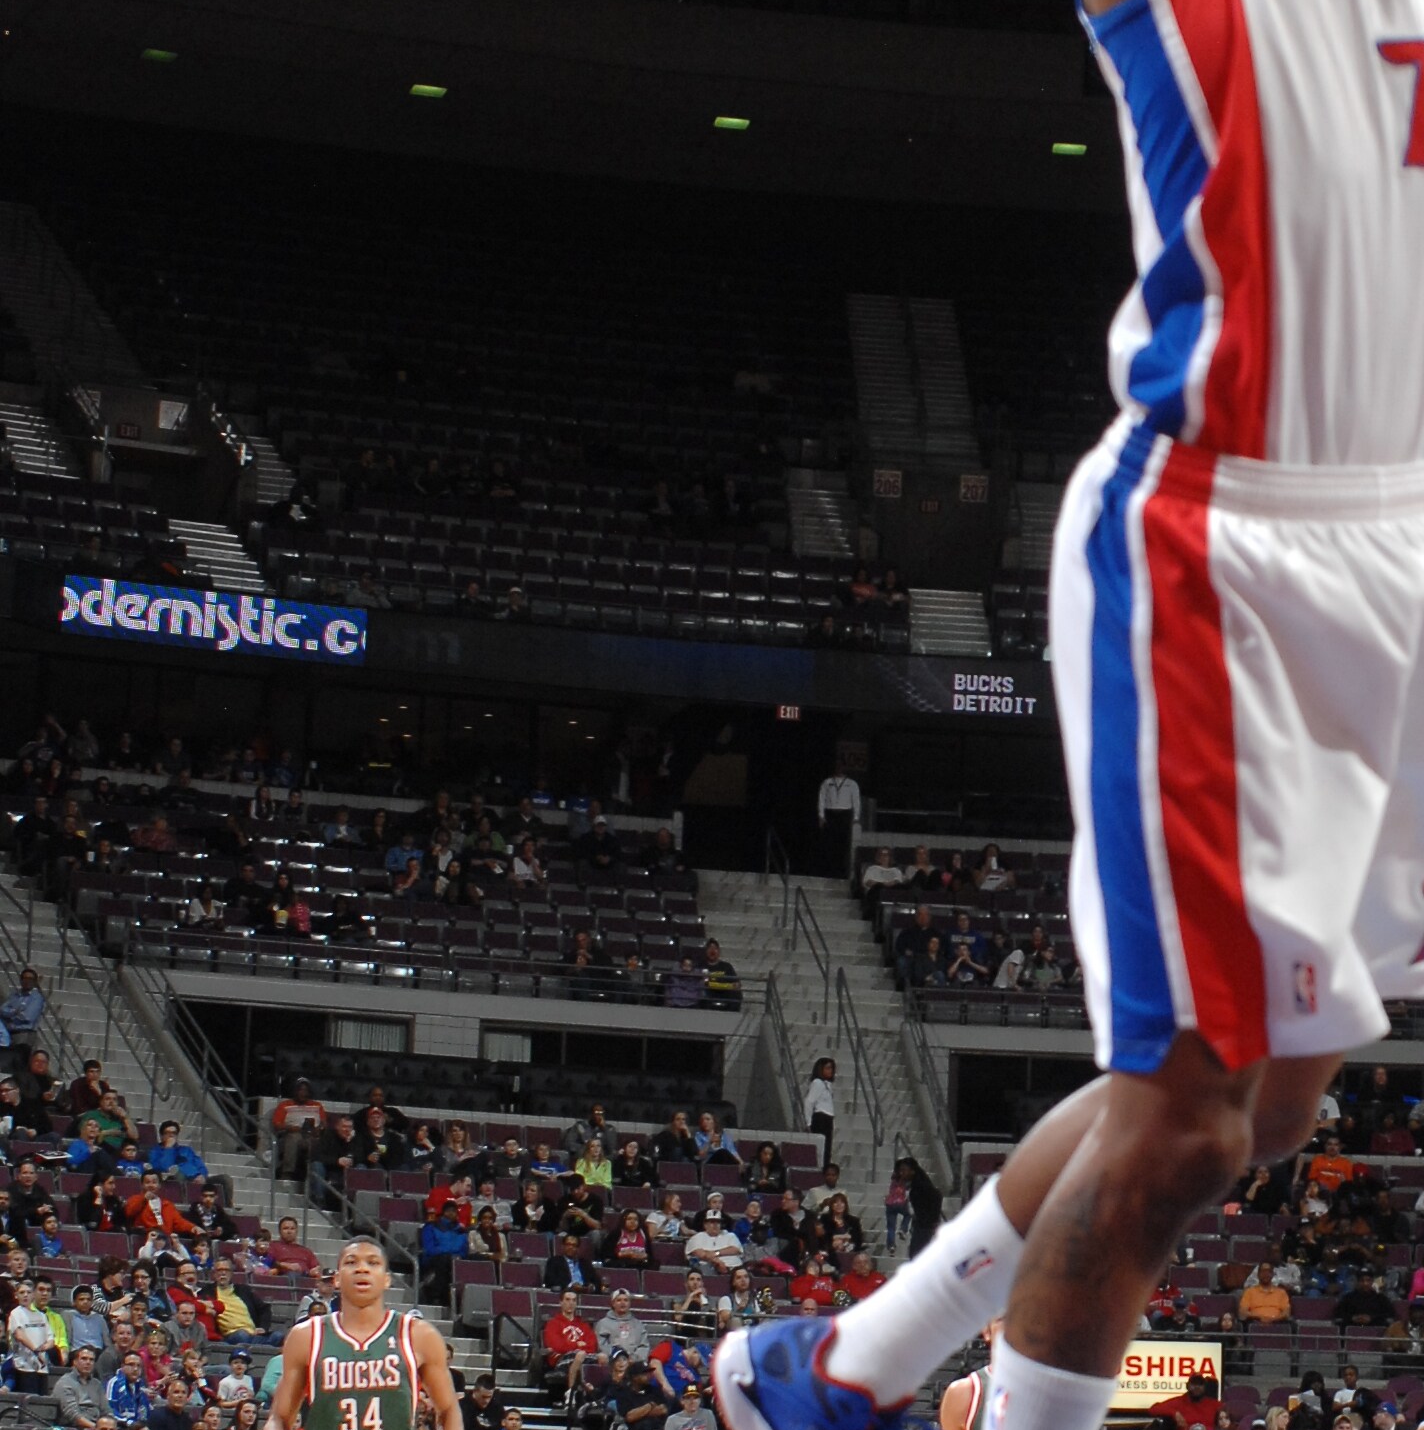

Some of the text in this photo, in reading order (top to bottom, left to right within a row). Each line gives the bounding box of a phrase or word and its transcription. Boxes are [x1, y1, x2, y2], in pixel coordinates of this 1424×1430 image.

[954, 673, 1014, 692] BUCKS
[953, 694, 1037, 714] DETROIT
[322, 1354, 401, 1391] BUCKS
[1125, 1355, 1217, 1377] SHIBA
